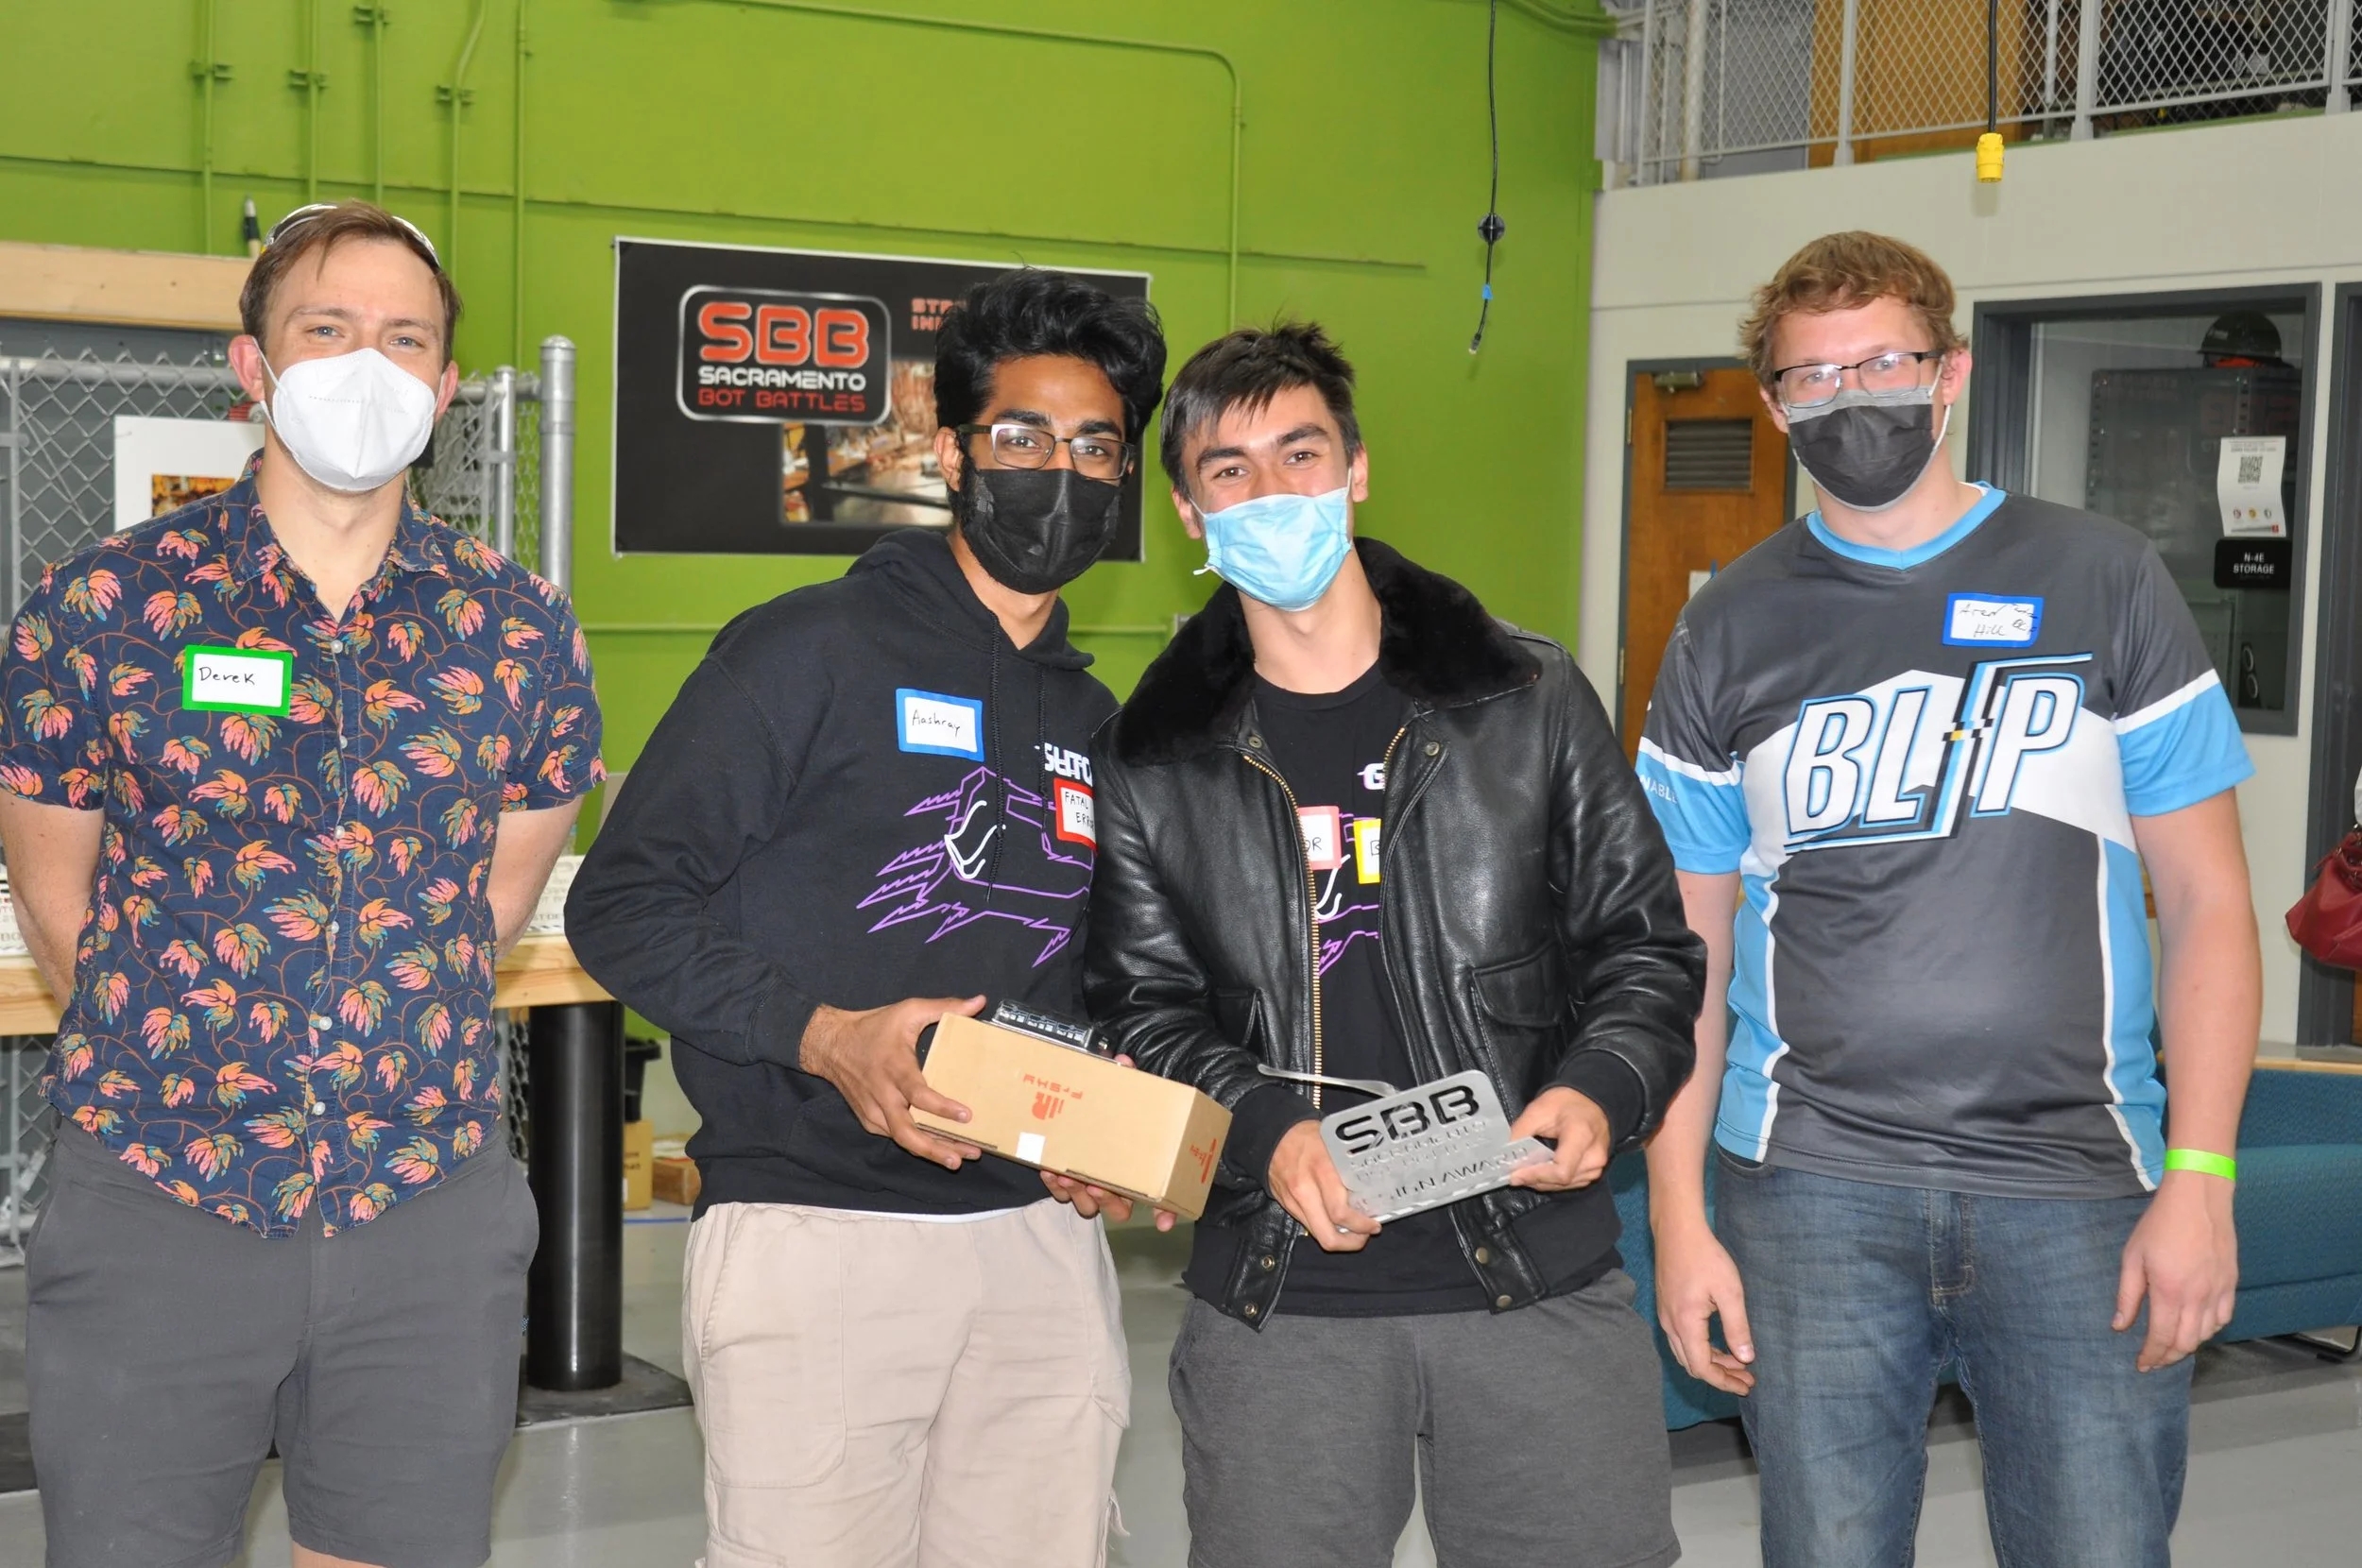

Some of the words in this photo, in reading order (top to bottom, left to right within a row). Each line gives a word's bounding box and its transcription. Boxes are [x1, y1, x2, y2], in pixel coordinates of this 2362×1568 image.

[698, 301, 869, 368] SBB
[698, 366, 866, 392] SACRAMENTO
[698, 388, 746, 406] BOT
[756, 390, 866, 412] BATTLES
[2233, 563, 2275, 574] STORAGE
[1784, 654, 2090, 846] BLIP
[1335, 1085, 1480, 1156] SBB
